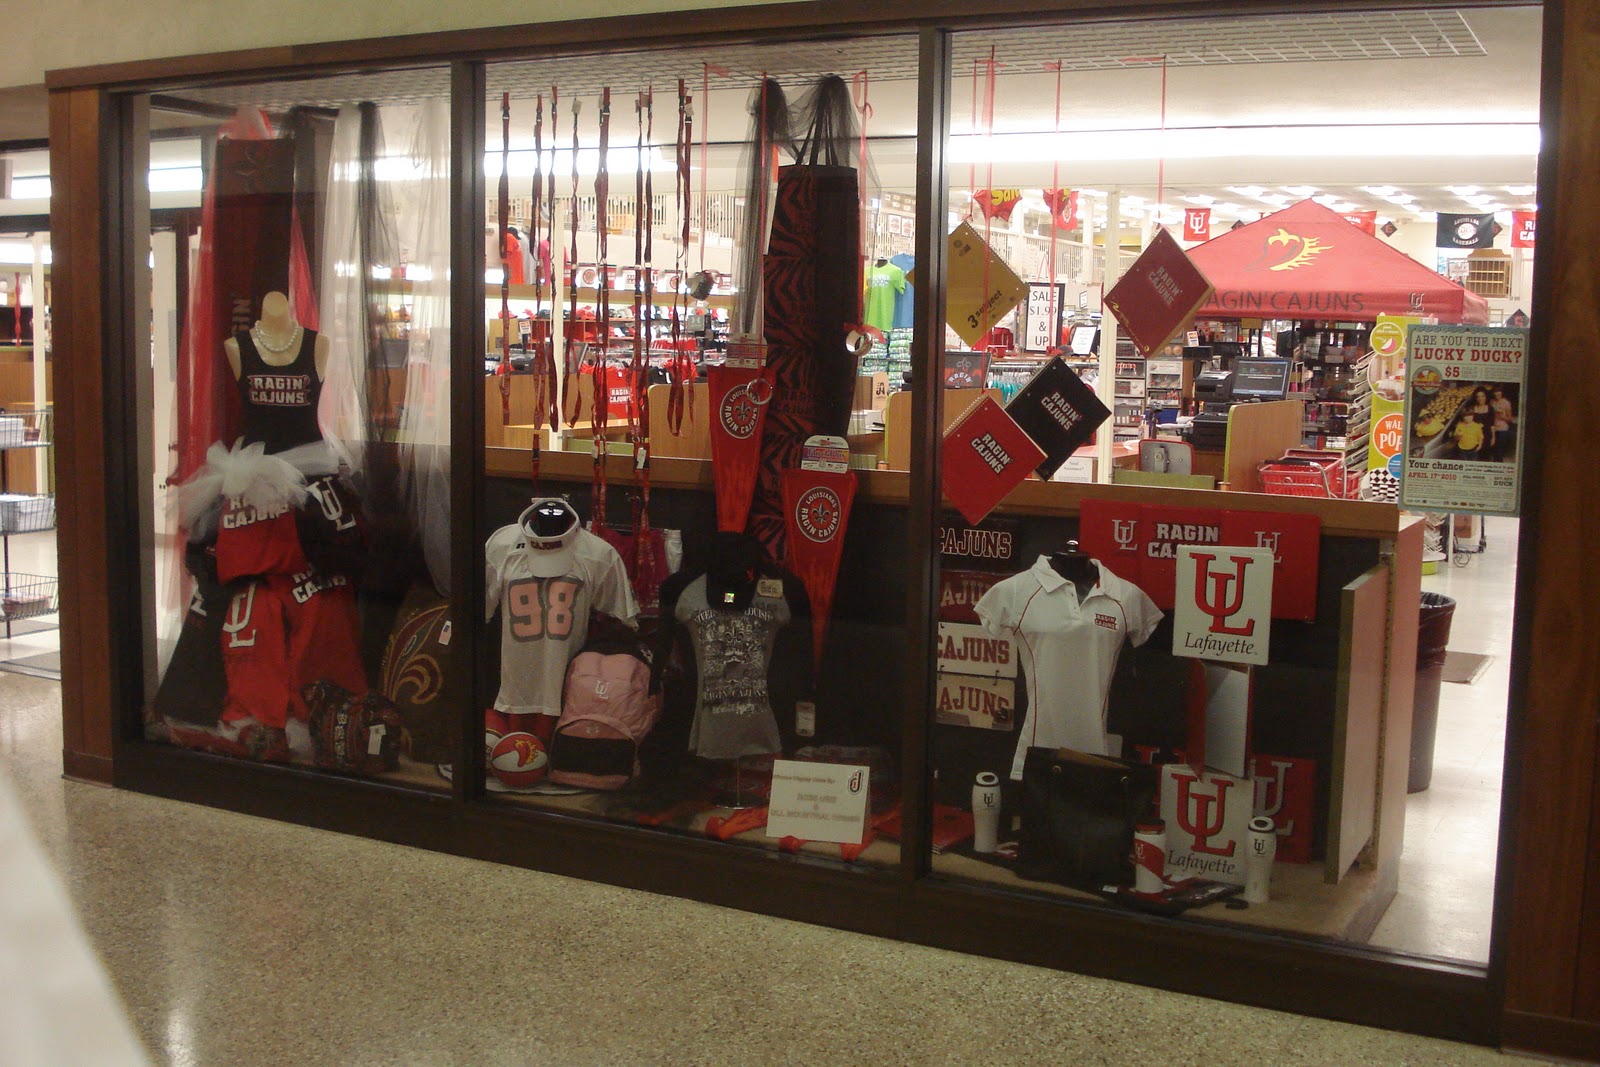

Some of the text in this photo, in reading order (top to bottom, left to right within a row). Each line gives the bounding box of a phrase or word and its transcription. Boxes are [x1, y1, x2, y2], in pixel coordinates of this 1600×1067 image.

[1032, 290, 1057, 302] SALE
[1205, 290, 1365, 313] AGIN' CAJUNS
[968, 315, 979, 329] 3
[1038, 321, 1047, 332] &
[1035, 335, 1049, 346] UP
[1414, 335, 1523, 349] ARE YOU THE NEXT
[1414, 347, 1522, 363] LUCKY DUCK?
[1445, 365, 1460, 378] $5
[254, 377, 303, 390] RAGIN
[251, 390, 305, 404] CAJUNS
[1041, 396, 1073, 431] CAJUNS
[1385, 420, 1402, 430] WAL
[1379, 432, 1402, 451] POP
[971, 437, 1005, 474] CAJUNS
[1408, 459, 1430, 469] Your
[1432, 461, 1464, 471] chance
[1408, 471, 1428, 479] APRIL
[1441, 473, 1457, 481] 2010
[801, 507, 839, 537] RAGIN CAJUNS
[1111, 519, 1139, 551] UL
[1156, 523, 1219, 542] RAGIN
[1188, 552, 1256, 637] UL
[508, 577, 585, 642] 98
[1184, 631, 1255, 656] Lafayette
[1170, 773, 1237, 858] UL
[1167, 849, 1236, 875] Lafayette
